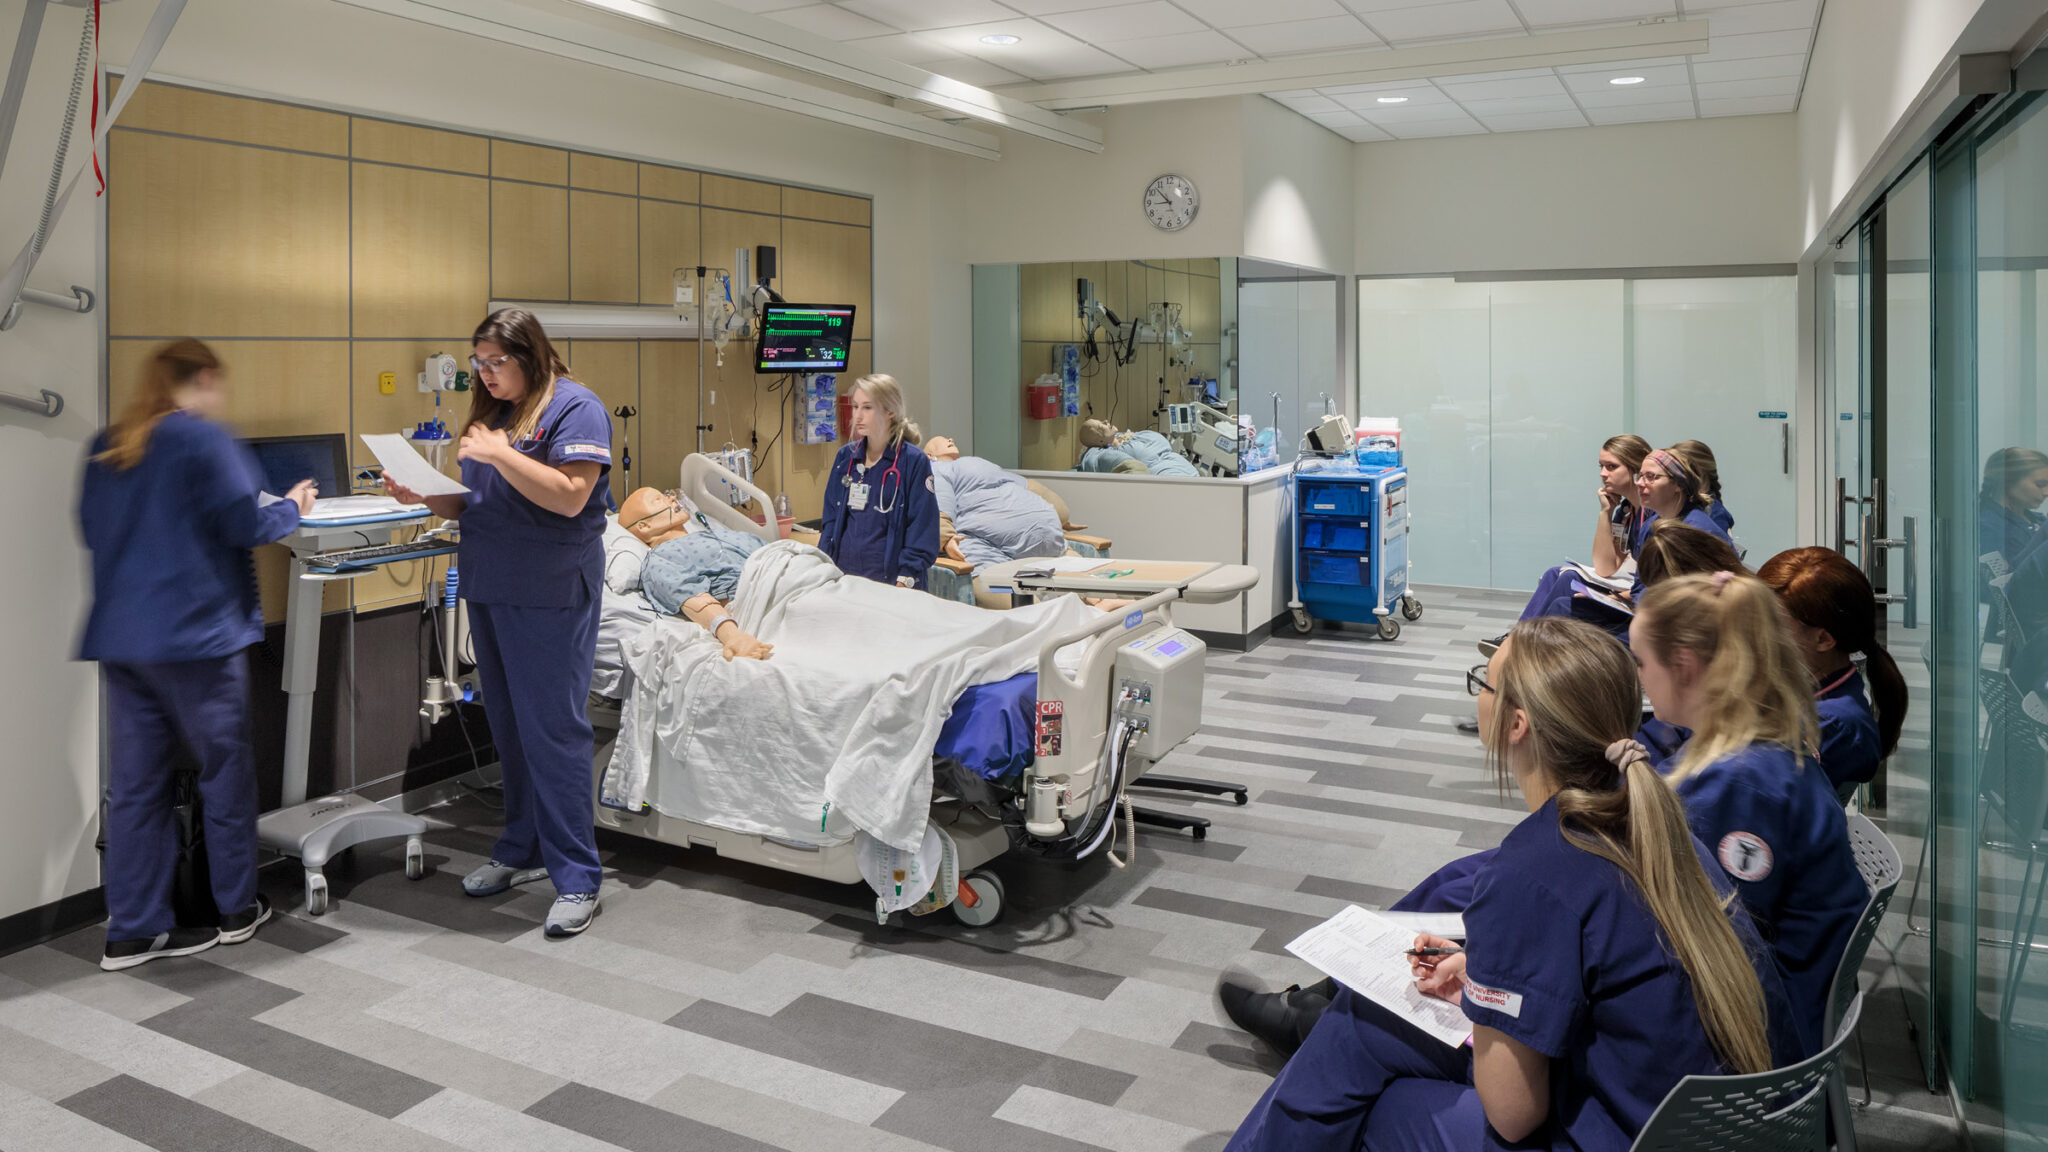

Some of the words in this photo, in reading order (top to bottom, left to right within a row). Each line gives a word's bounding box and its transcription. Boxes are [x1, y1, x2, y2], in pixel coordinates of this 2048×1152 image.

[1157, 180, 1163, 189] 11
[1166, 176, 1174, 185] 12
[1148, 188, 1156, 197] 10
[1184, 187, 1190, 196] 2
[1146, 199, 1152, 208] 9
[1187, 197, 1193, 206] 3
[1149, 208, 1155, 218] 8
[1184, 208, 1190, 216] 4
[1157, 217, 1163, 226] 7
[1166, 219, 1172, 228] 6
[1176, 216, 1182, 225] 5
[828, 318, 842, 327] 119
[823, 350, 833, 360] 32
[1041, 701, 1062, 714] CPR
[1473, 984, 1510, 1000] UNIVERSITY
[1475, 993, 1505, 1006] NURSING
